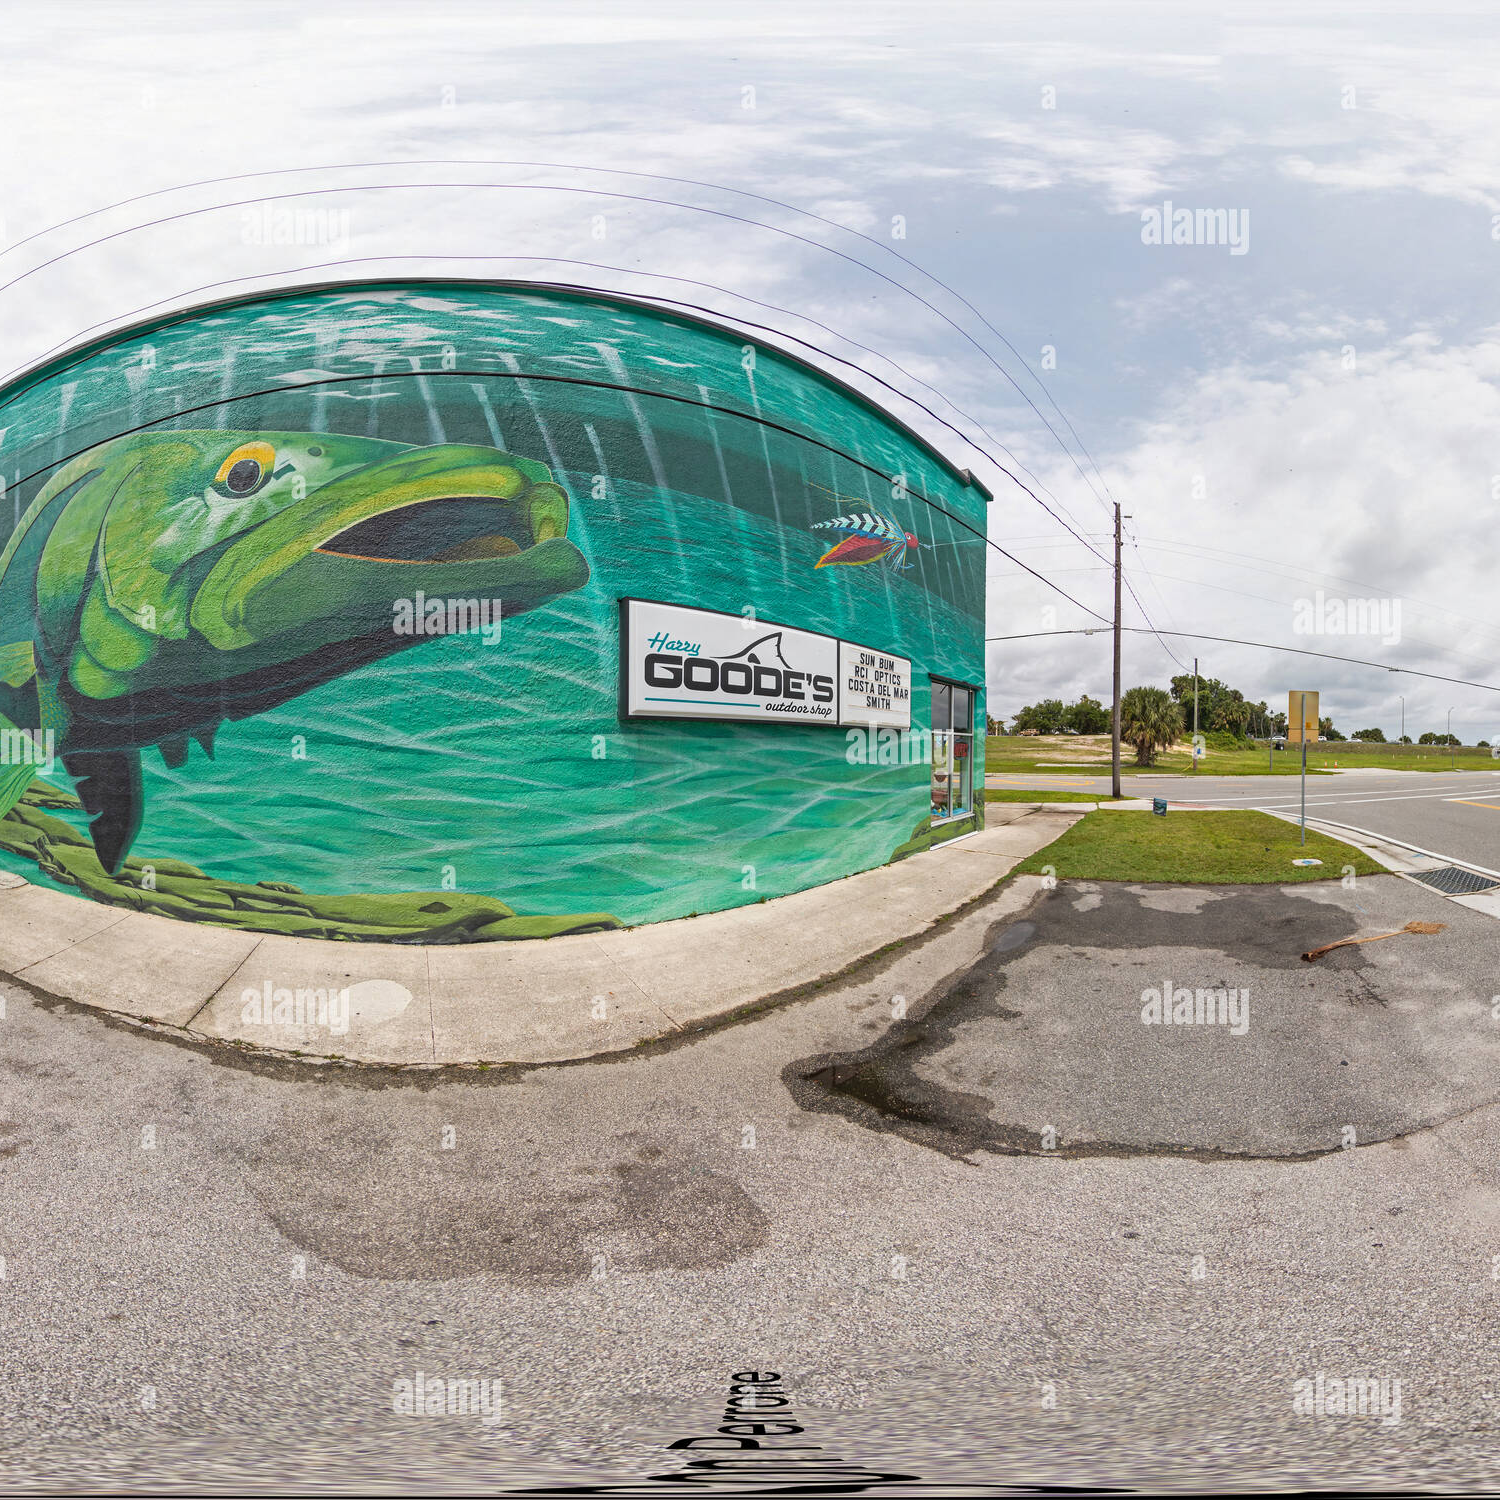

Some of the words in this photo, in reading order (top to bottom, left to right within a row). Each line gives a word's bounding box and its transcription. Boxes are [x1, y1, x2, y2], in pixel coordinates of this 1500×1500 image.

[647, 631, 701, 656] Harry
[860, 653, 875, 667] SUN
[879, 658, 894, 671] BUM
[644, 653, 834, 702] GOODE'S
[854, 665, 868, 679] RCI
[874, 670, 901, 685] OPTICS
[848, 678, 875, 694] COSTA
[877, 684, 891, 697] DEL
[894, 687, 908, 700] MAR
[765, 701, 809, 714] outdoor
[810, 704, 833, 718] shop
[866, 695, 891, 709] SMITH
